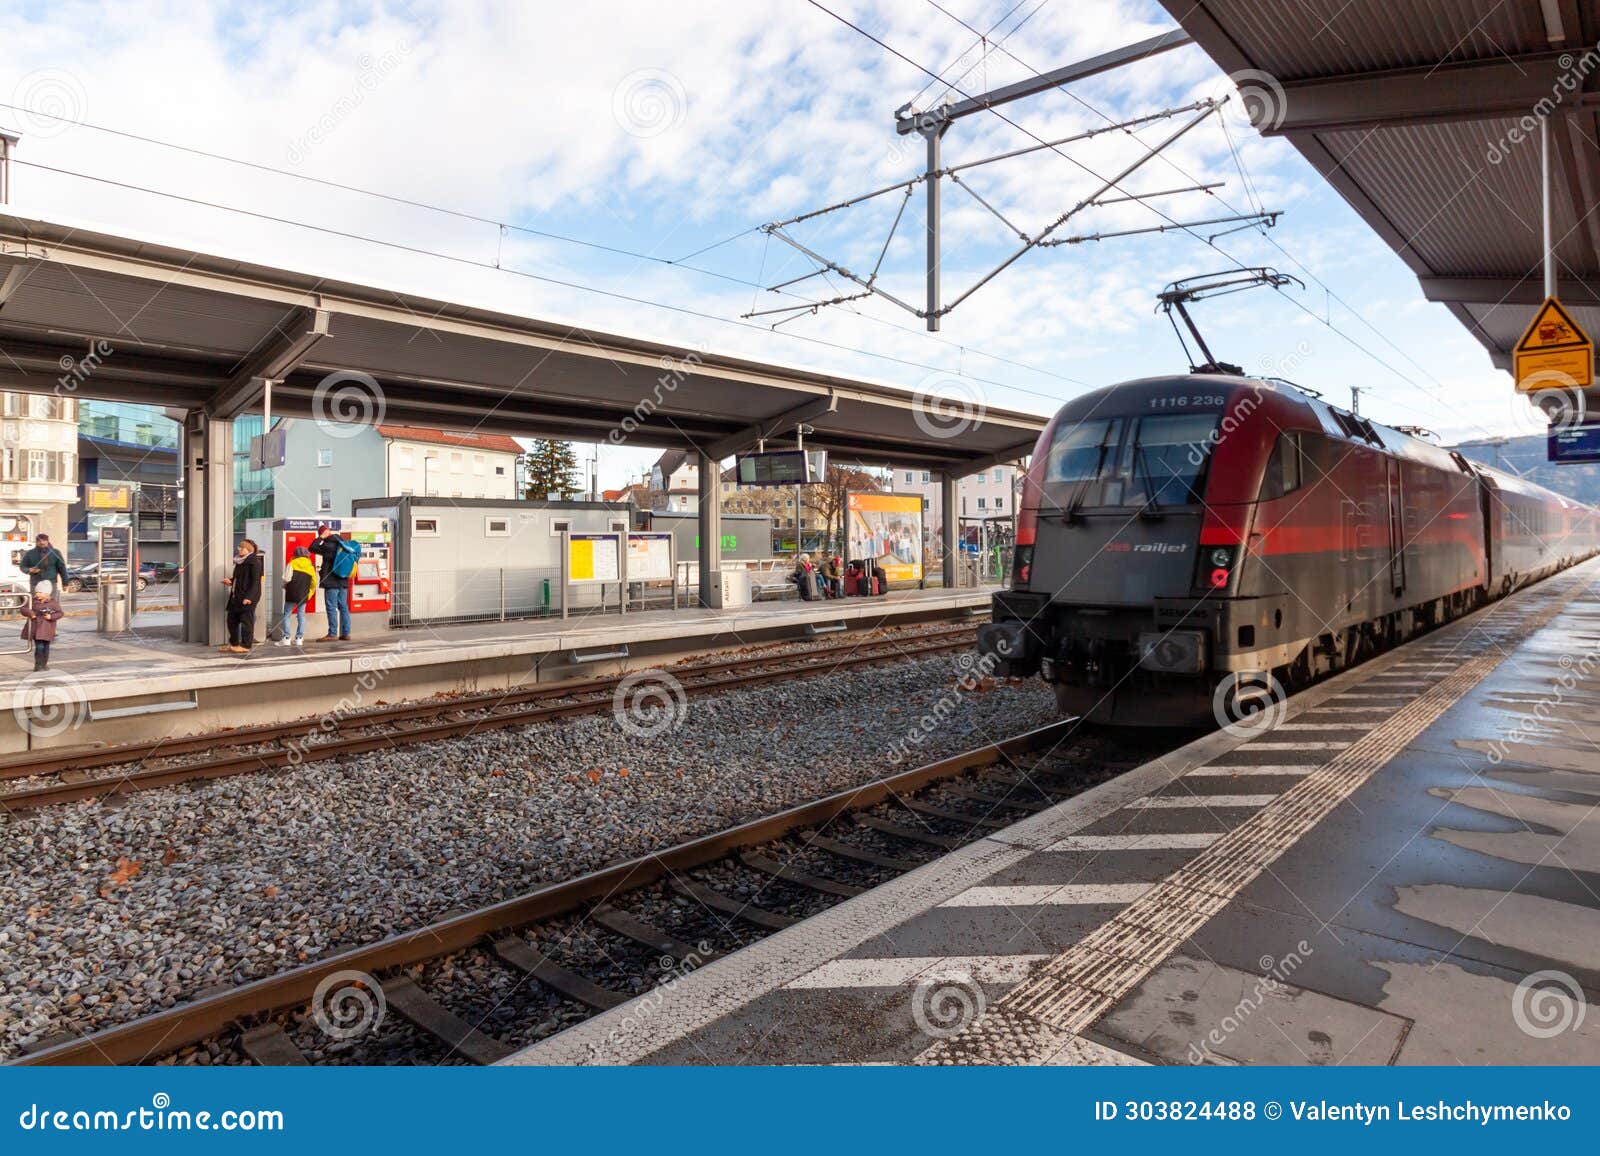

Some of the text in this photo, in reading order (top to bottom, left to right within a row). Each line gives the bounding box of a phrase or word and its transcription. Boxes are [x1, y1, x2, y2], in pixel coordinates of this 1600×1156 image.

[1150, 395, 1225, 408] 1116 236
[1133, 542, 1187, 555] railjet
